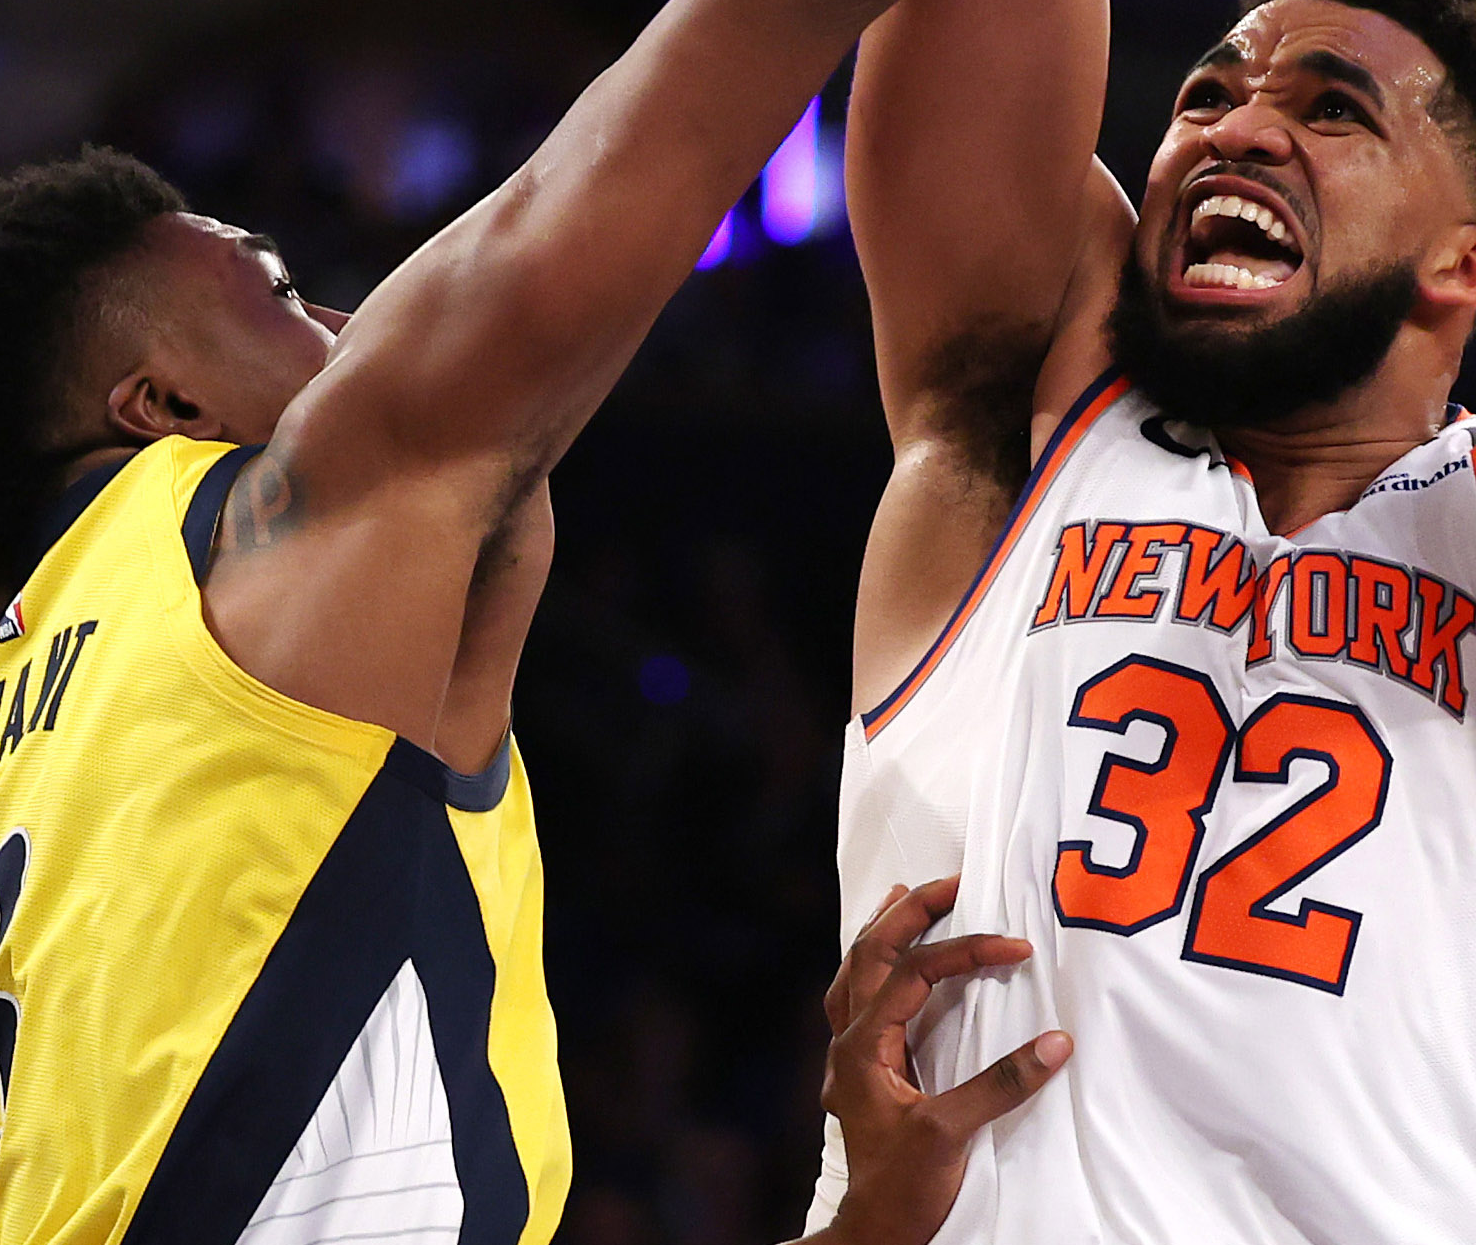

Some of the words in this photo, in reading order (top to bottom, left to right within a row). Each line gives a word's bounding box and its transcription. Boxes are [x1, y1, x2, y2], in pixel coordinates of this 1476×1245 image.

[1391, 454, 1469, 492] dhabi
[1027, 517, 1258, 637] NEW
[1052, 653, 1394, 997] 32
